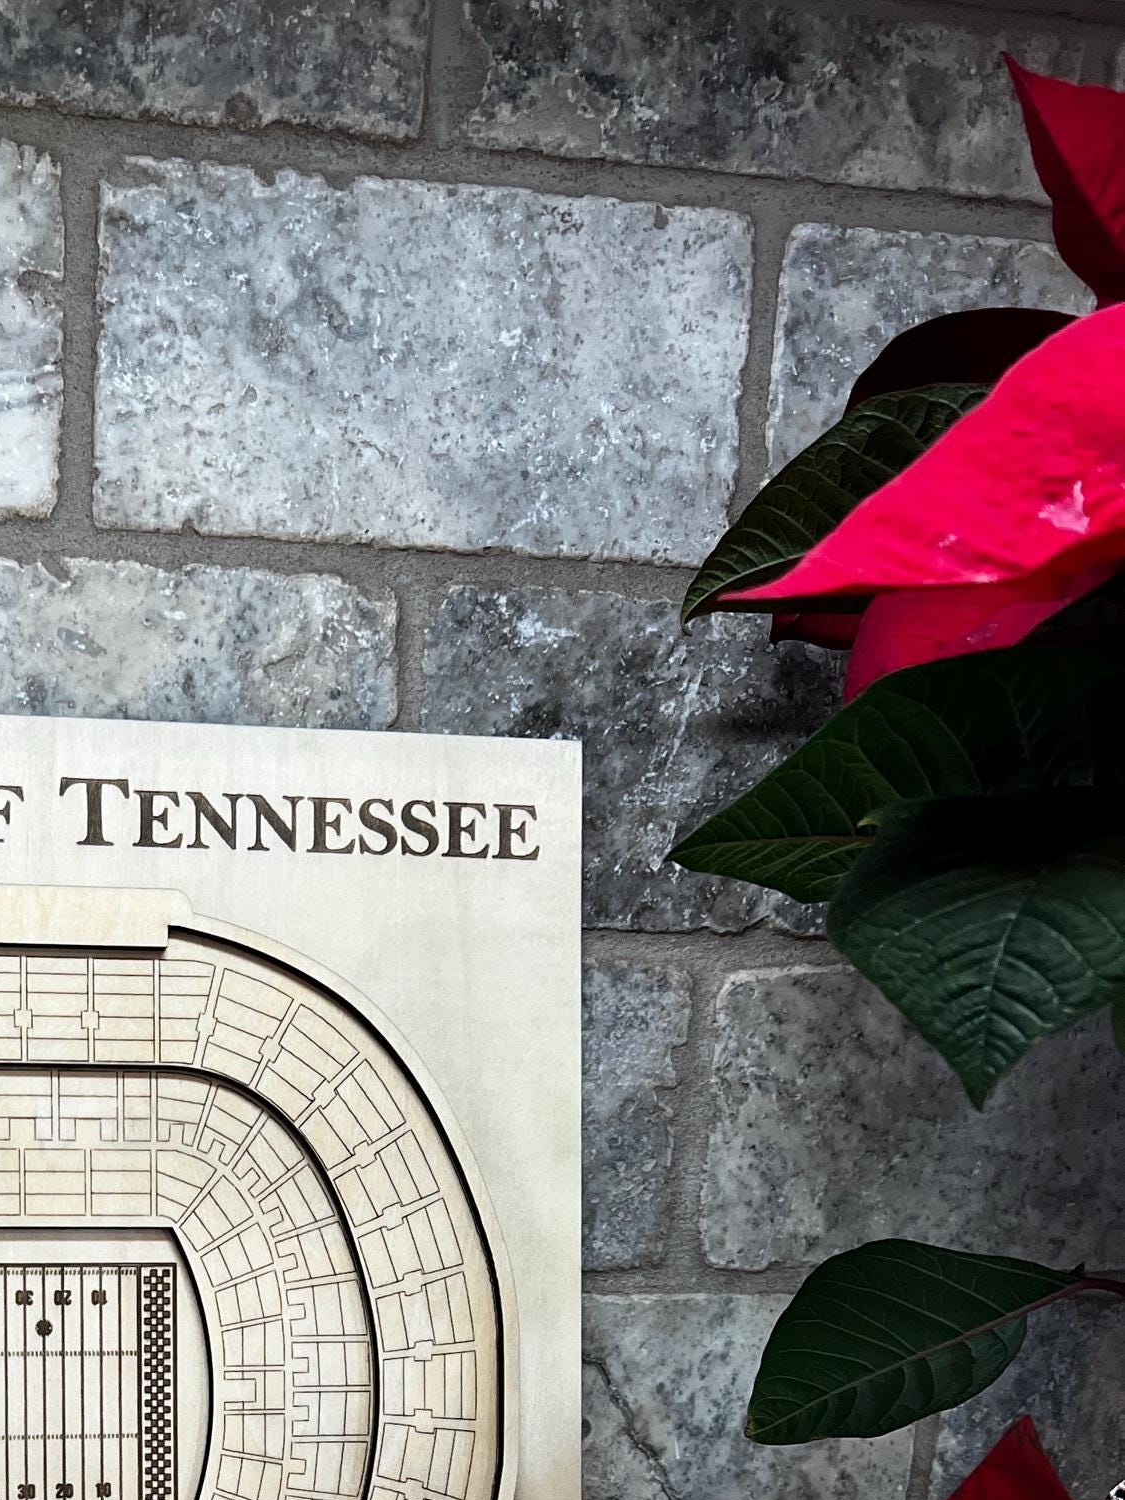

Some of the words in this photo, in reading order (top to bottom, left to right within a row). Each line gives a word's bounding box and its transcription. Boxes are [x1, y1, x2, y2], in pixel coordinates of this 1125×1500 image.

[60, 777, 539, 860] TENNESSEE
[17, 1484, 36, 1500] 30
[56, 1483, 73, 1499] 20
[96, 1482, 111, 1498] 10
